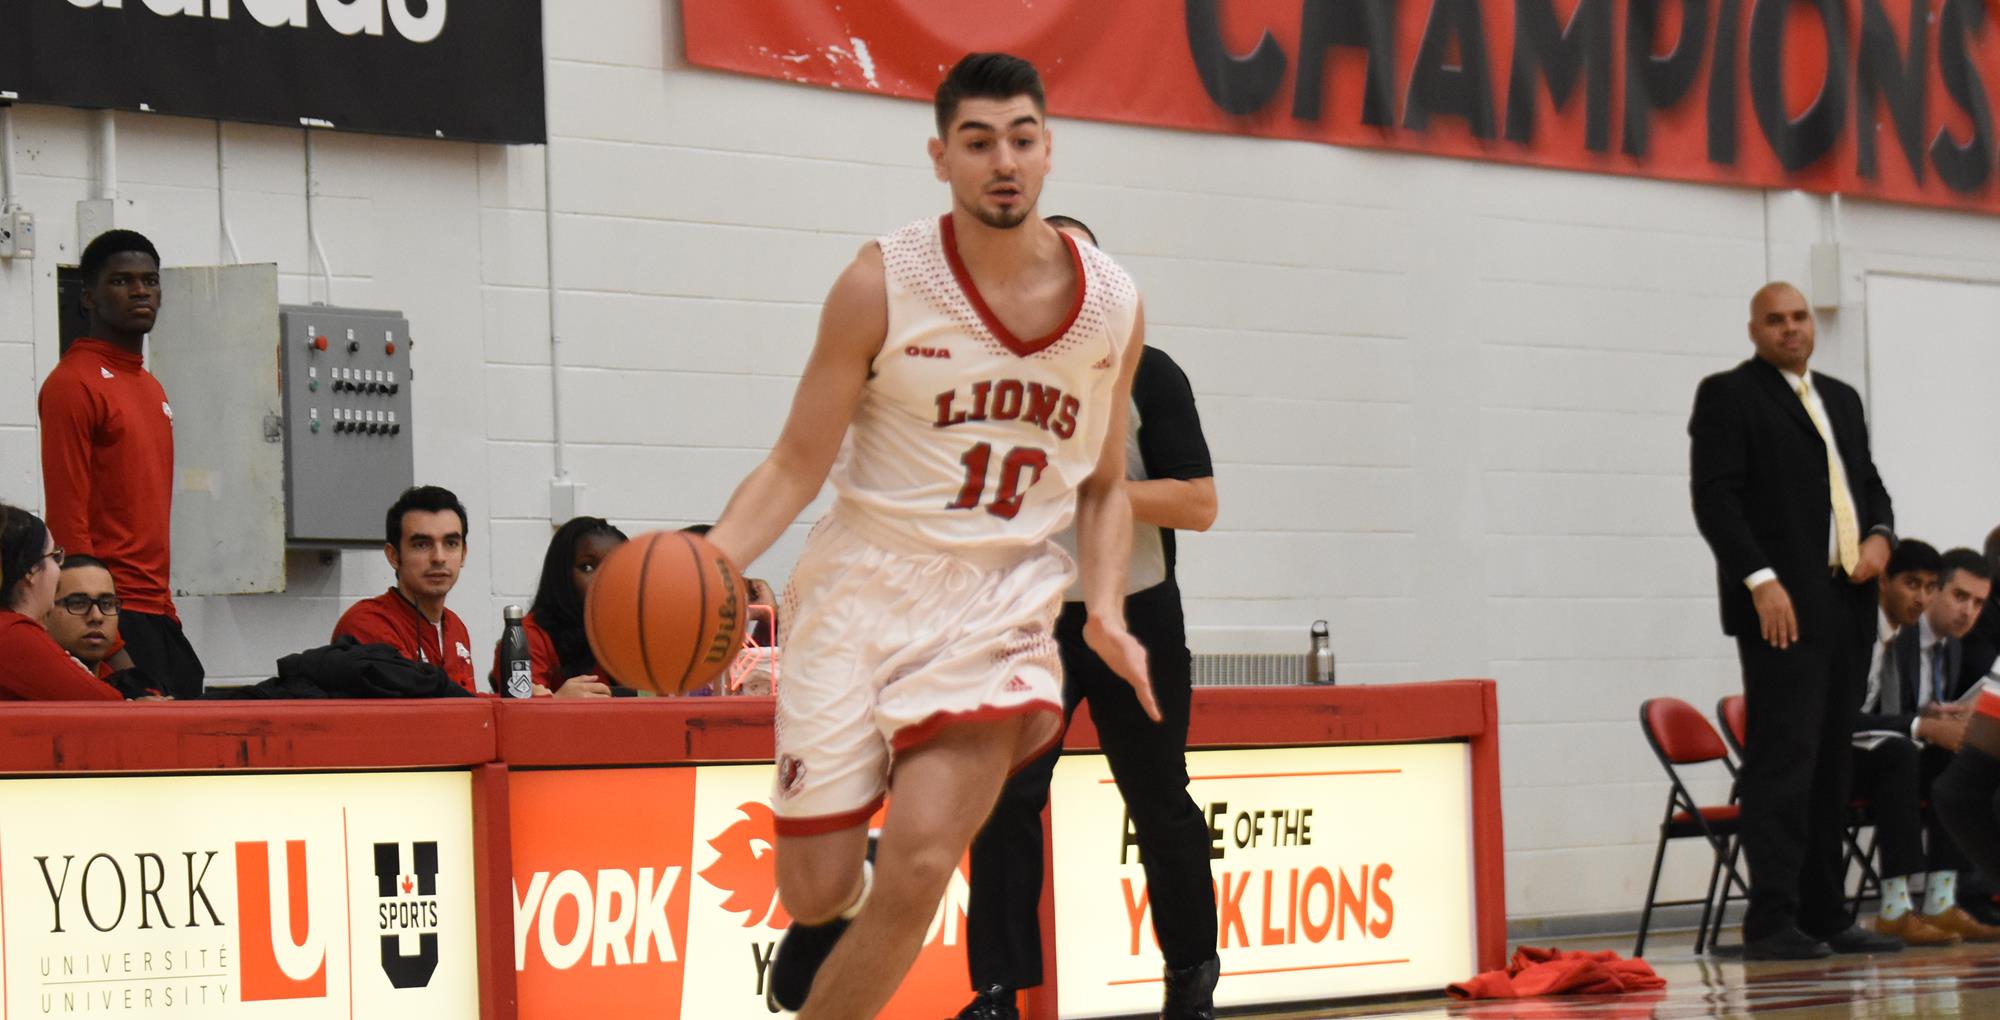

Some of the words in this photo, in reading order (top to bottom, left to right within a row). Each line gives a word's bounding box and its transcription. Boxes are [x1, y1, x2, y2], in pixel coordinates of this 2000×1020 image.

[1186, 0, 1994, 194] CHAMPIONS
[904, 345, 952, 360] OUA
[932, 379, 1080, 440] LIONS
[944, 440, 1049, 521] 10
[1234, 811, 1265, 849] OF
[1271, 808, 1313, 847] THE
[33, 850, 226, 933] YORK
[379, 901, 438, 930] SPORTS
[511, 866, 682, 971] YORK
[1120, 870, 1252, 956] YK
[1260, 862, 1395, 947] LIONS
[41, 944, 228, 977] UNIVERSITÉ
[41, 984, 228, 1014] UNIVERSITY
